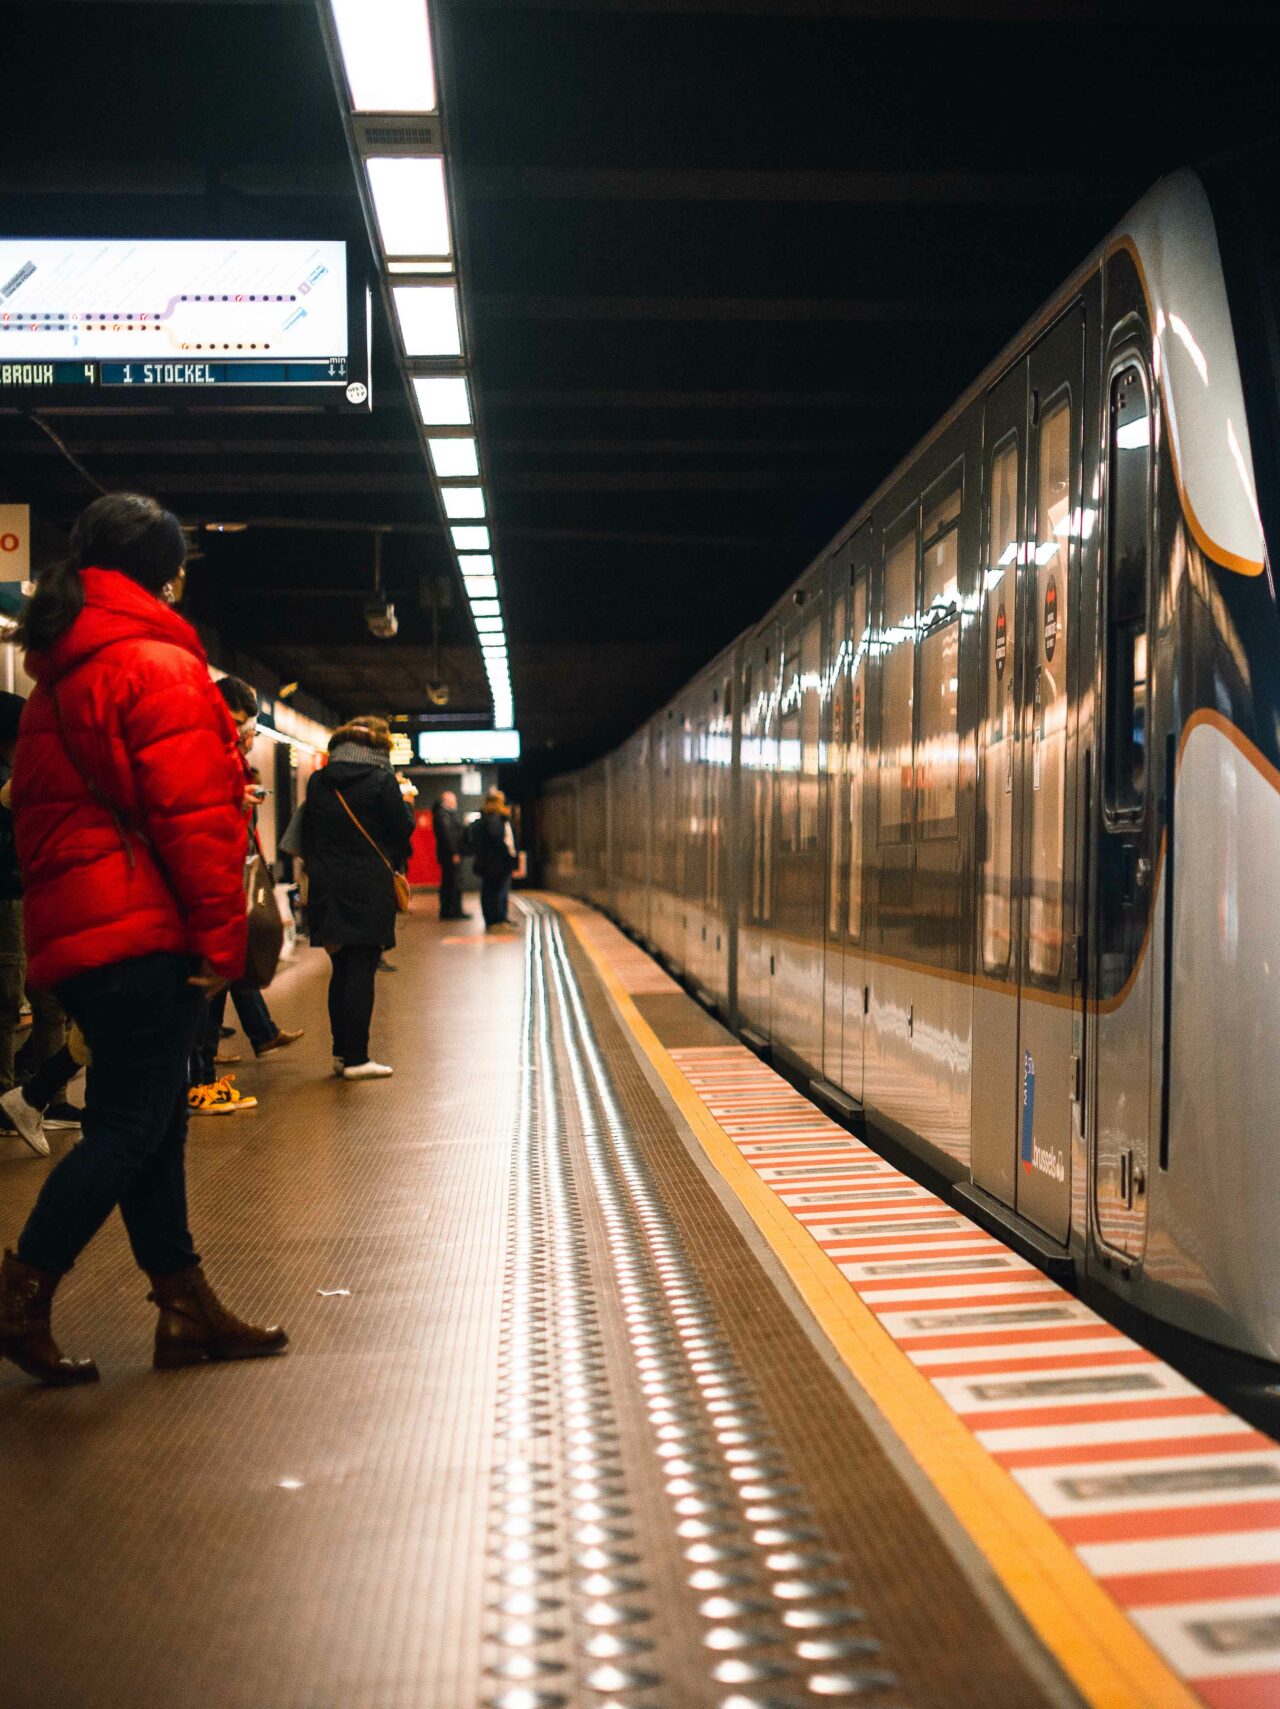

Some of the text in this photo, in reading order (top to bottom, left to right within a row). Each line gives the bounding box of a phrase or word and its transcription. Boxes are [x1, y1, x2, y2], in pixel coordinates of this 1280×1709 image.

[0, 364, 94, 384] BROUX 4
[123, 364, 215, 384] 1 STOCKEL
